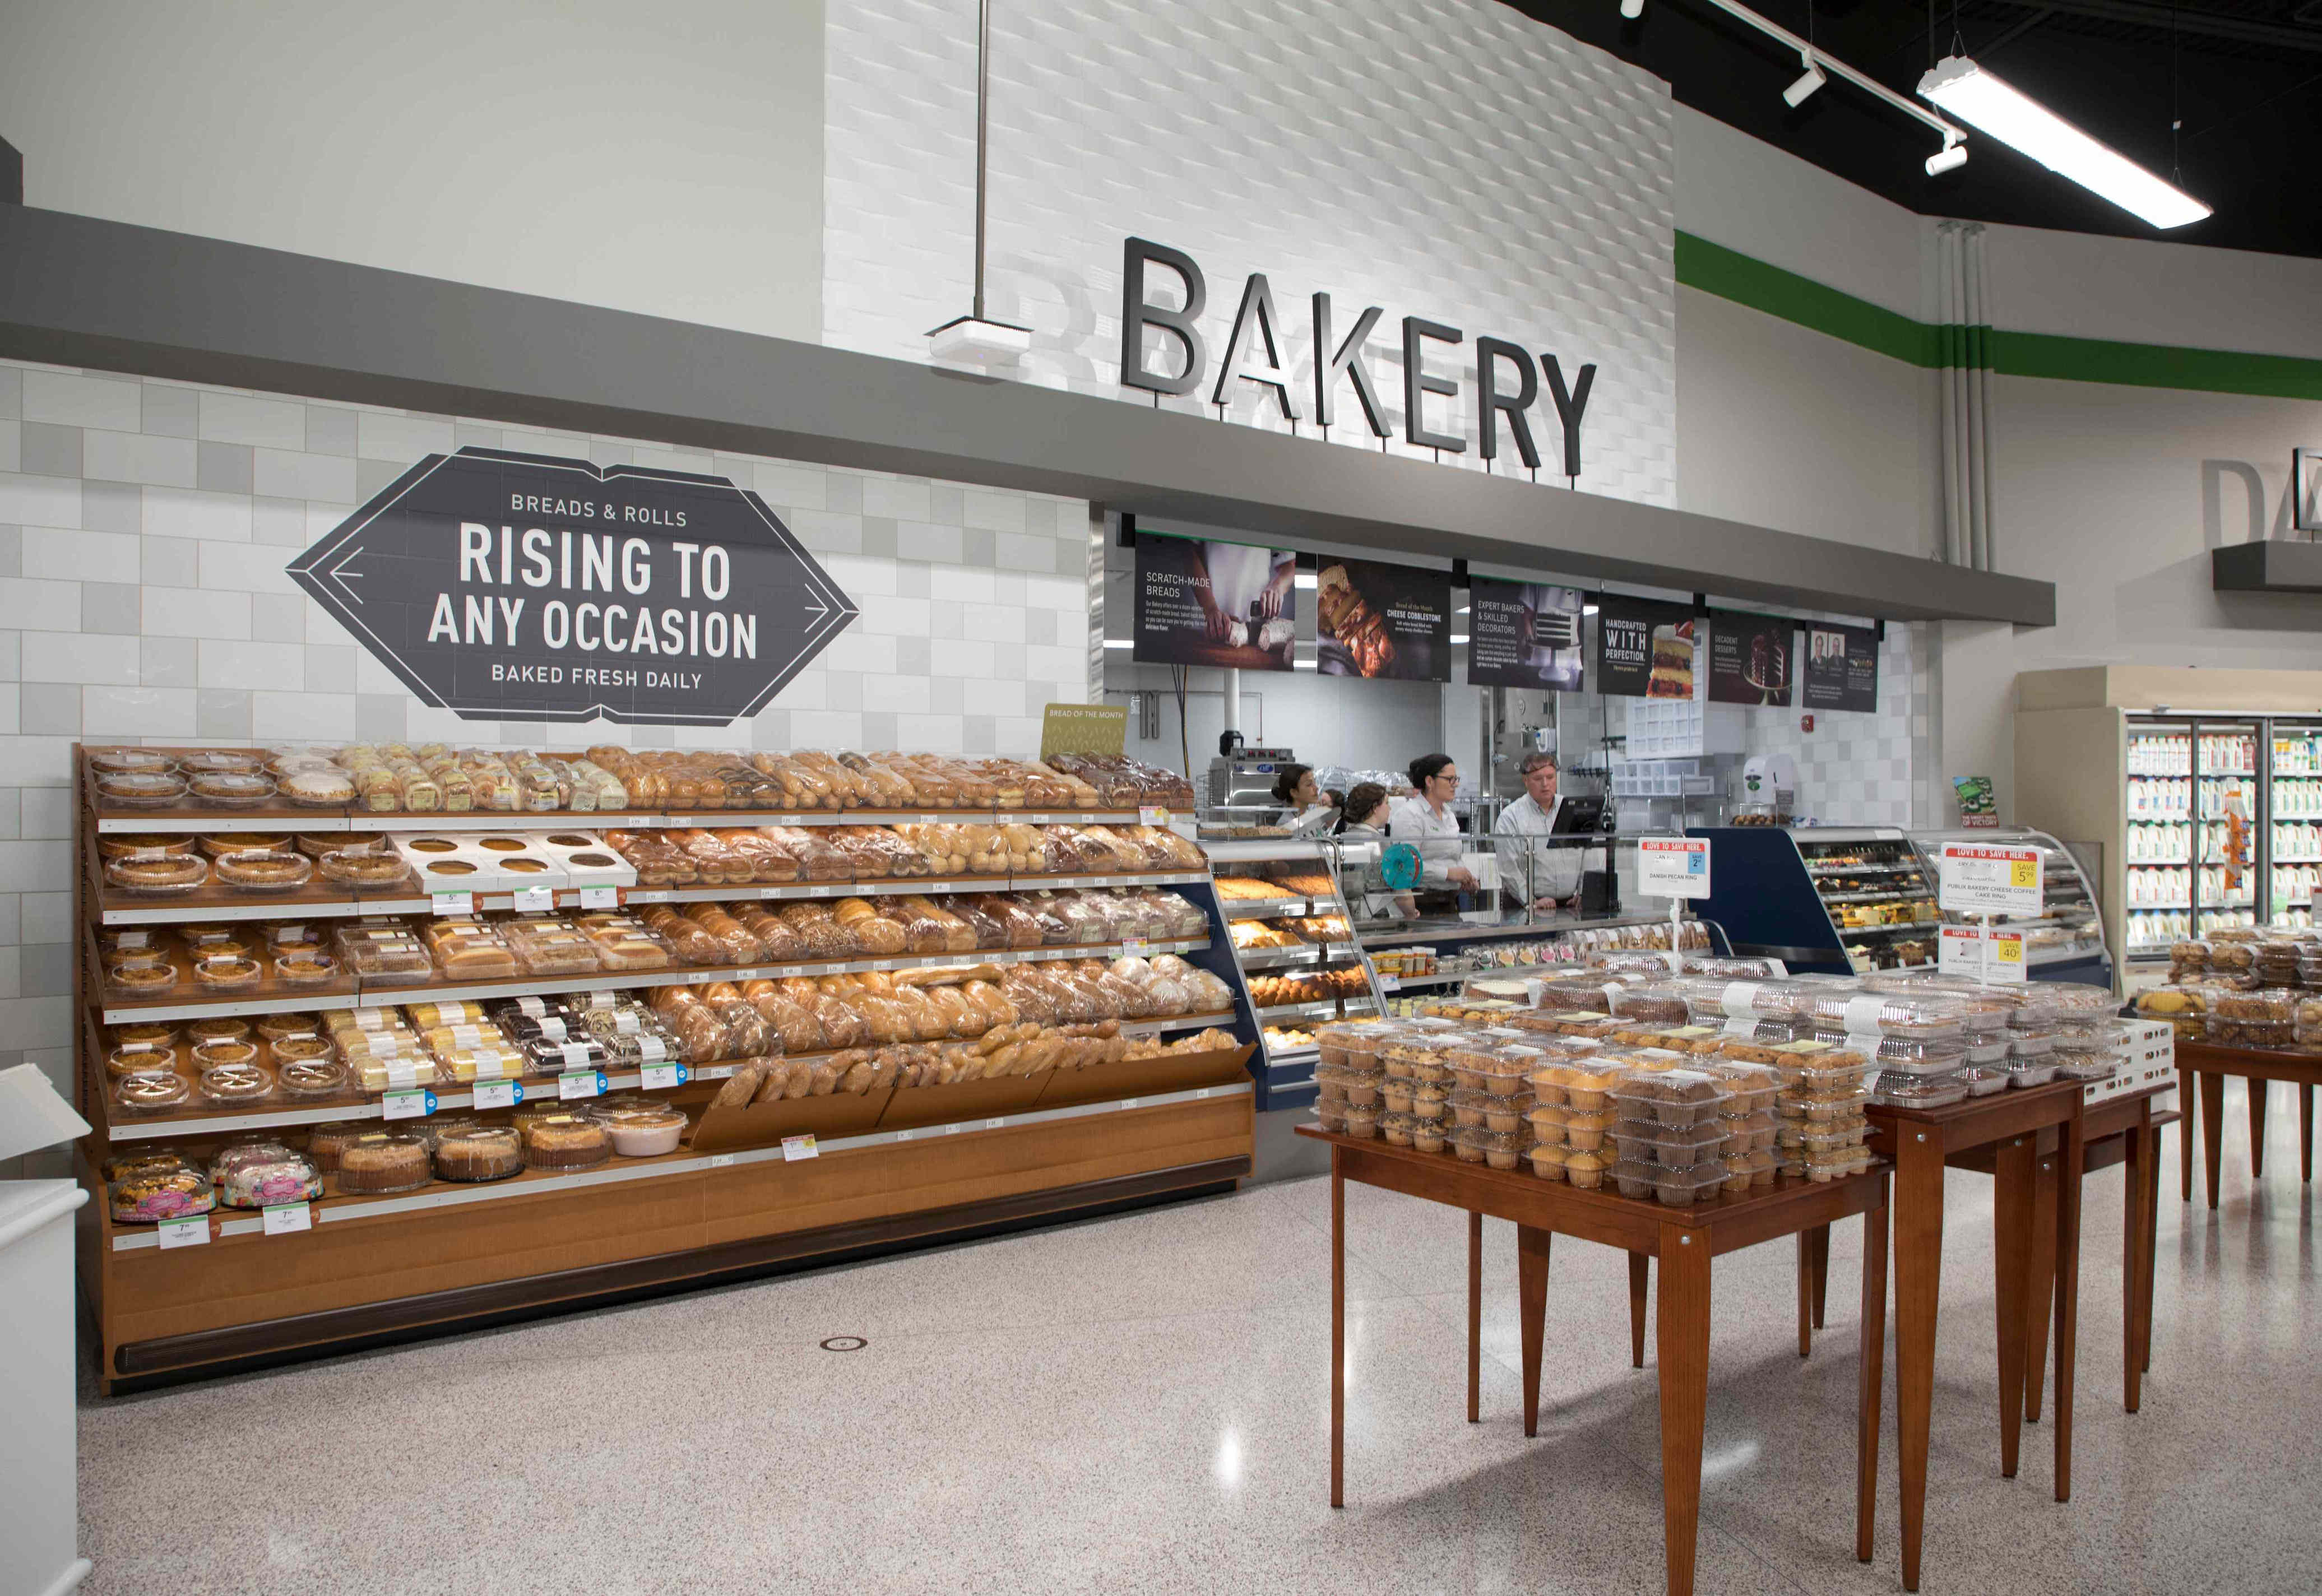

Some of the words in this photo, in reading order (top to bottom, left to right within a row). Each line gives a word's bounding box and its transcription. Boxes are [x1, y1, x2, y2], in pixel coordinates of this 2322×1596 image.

[1121, 236, 1596, 477] BAKERY
[511, 494, 595, 519] BREADS
[604, 503, 615, 520] &
[625, 505, 687, 527] ROLLS
[459, 522, 651, 595] RISING
[673, 542, 730, 601] TO
[1146, 572, 1211, 587] SCRATCH-MADE
[1147, 585, 1180, 597] BREADS
[1387, 609, 1406, 619] CHEESE
[1478, 600, 1500, 611] EXPERT
[1501, 603, 1524, 614] BAKERS
[1478, 612, 1482, 620] &
[1484, 613, 1508, 623] SKILLED
[427, 593, 525, 647] ANY
[543, 600, 757, 659] OCCASION
[1477, 623, 1515, 634] DECORATORS
[1606, 619, 1646, 631] HANDCRAFTED
[1606, 629, 1646, 650] WITH
[1606, 648, 1645, 662] PERFECTION.
[492, 664, 562, 684] BAKED
[572, 667, 637, 687] FRESH
[647, 671, 702, 690] DAILY
[1049, 709, 1072, 717] BREAD
[1957, 848, 1974, 856] LOVE
[1990, 850, 2006, 858] SAVE
